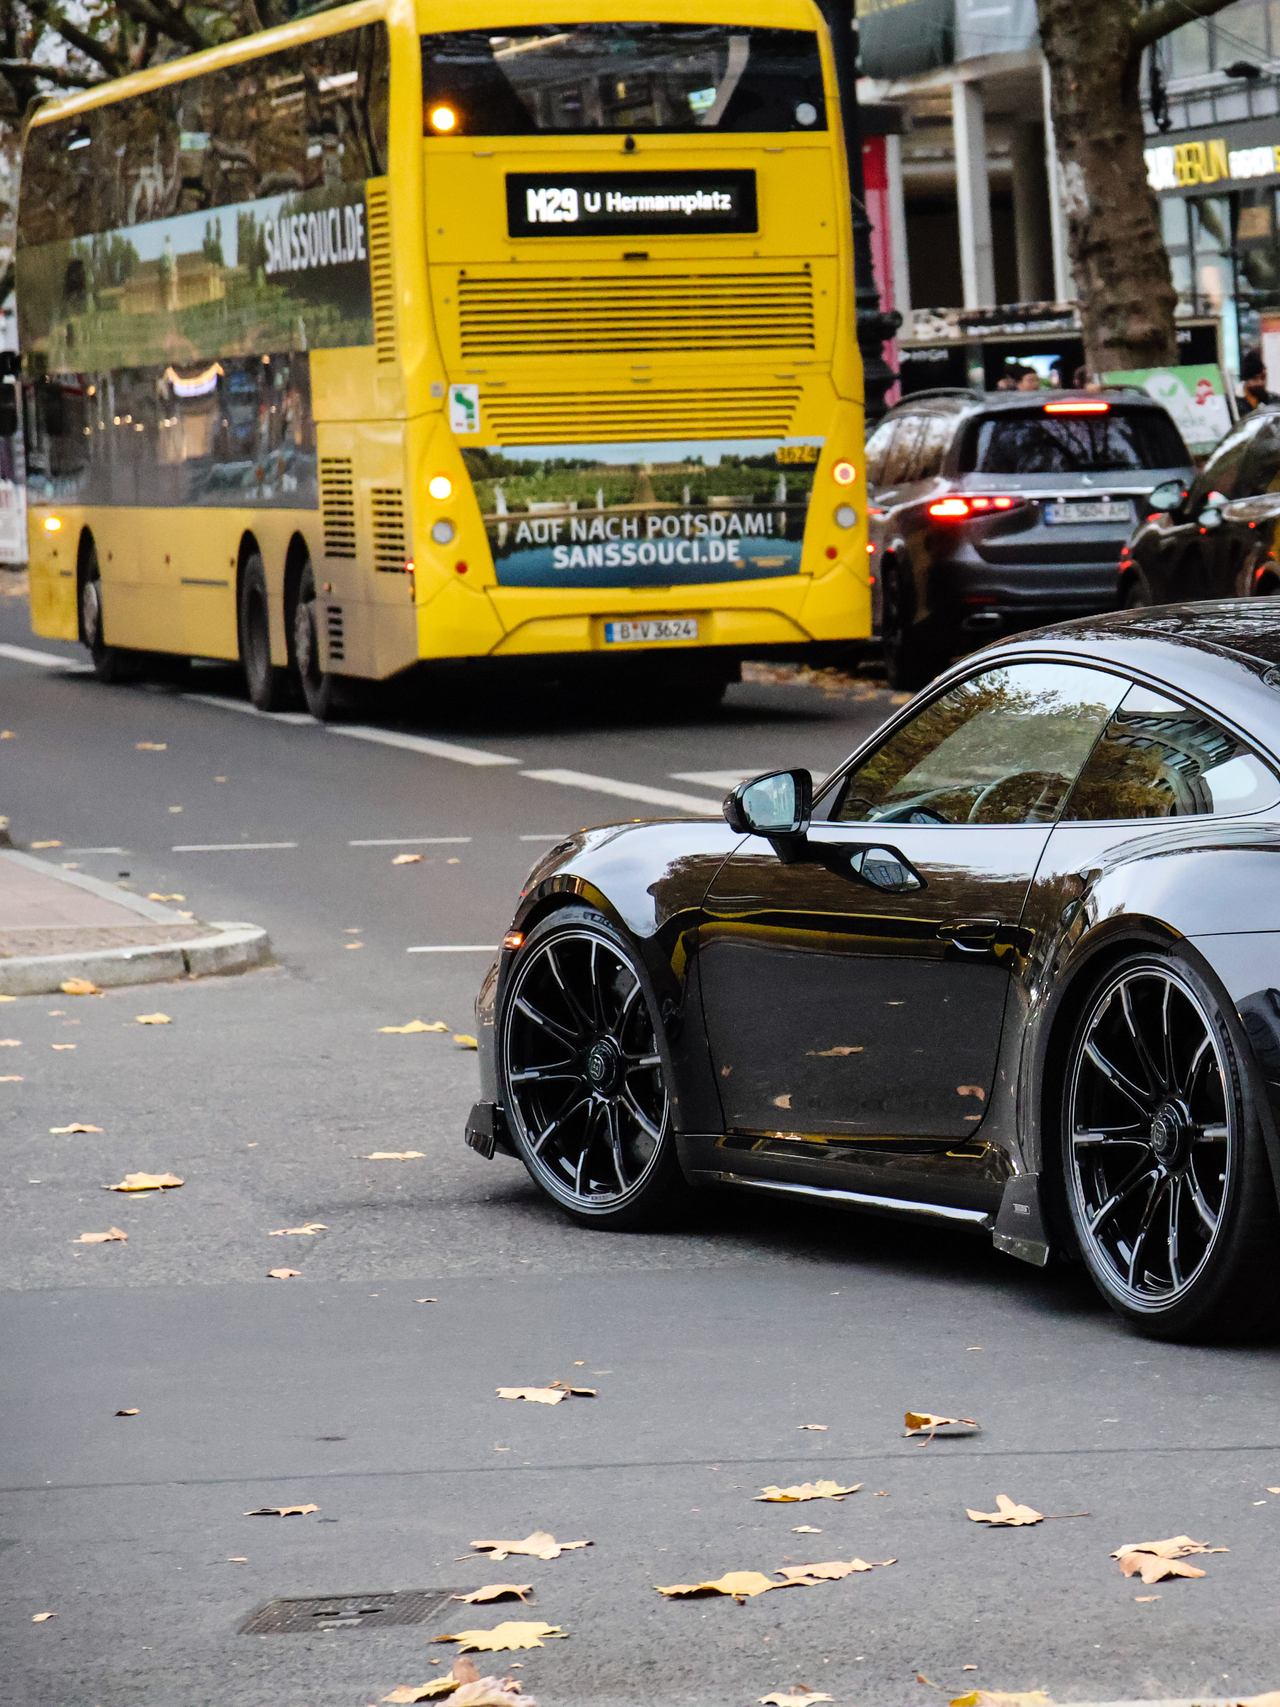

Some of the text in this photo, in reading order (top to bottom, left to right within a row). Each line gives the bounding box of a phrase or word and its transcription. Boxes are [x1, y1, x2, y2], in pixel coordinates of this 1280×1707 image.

[526, 188, 732, 223] M29 U Hermannplatz
[265, 203, 366, 273] SANSSOUCI.DE
[516, 512, 774, 544] AUF NACH POTSDAM!
[552, 540, 741, 569] SANSSOUCI.DE
[621, 621, 692, 639] B V 3624
